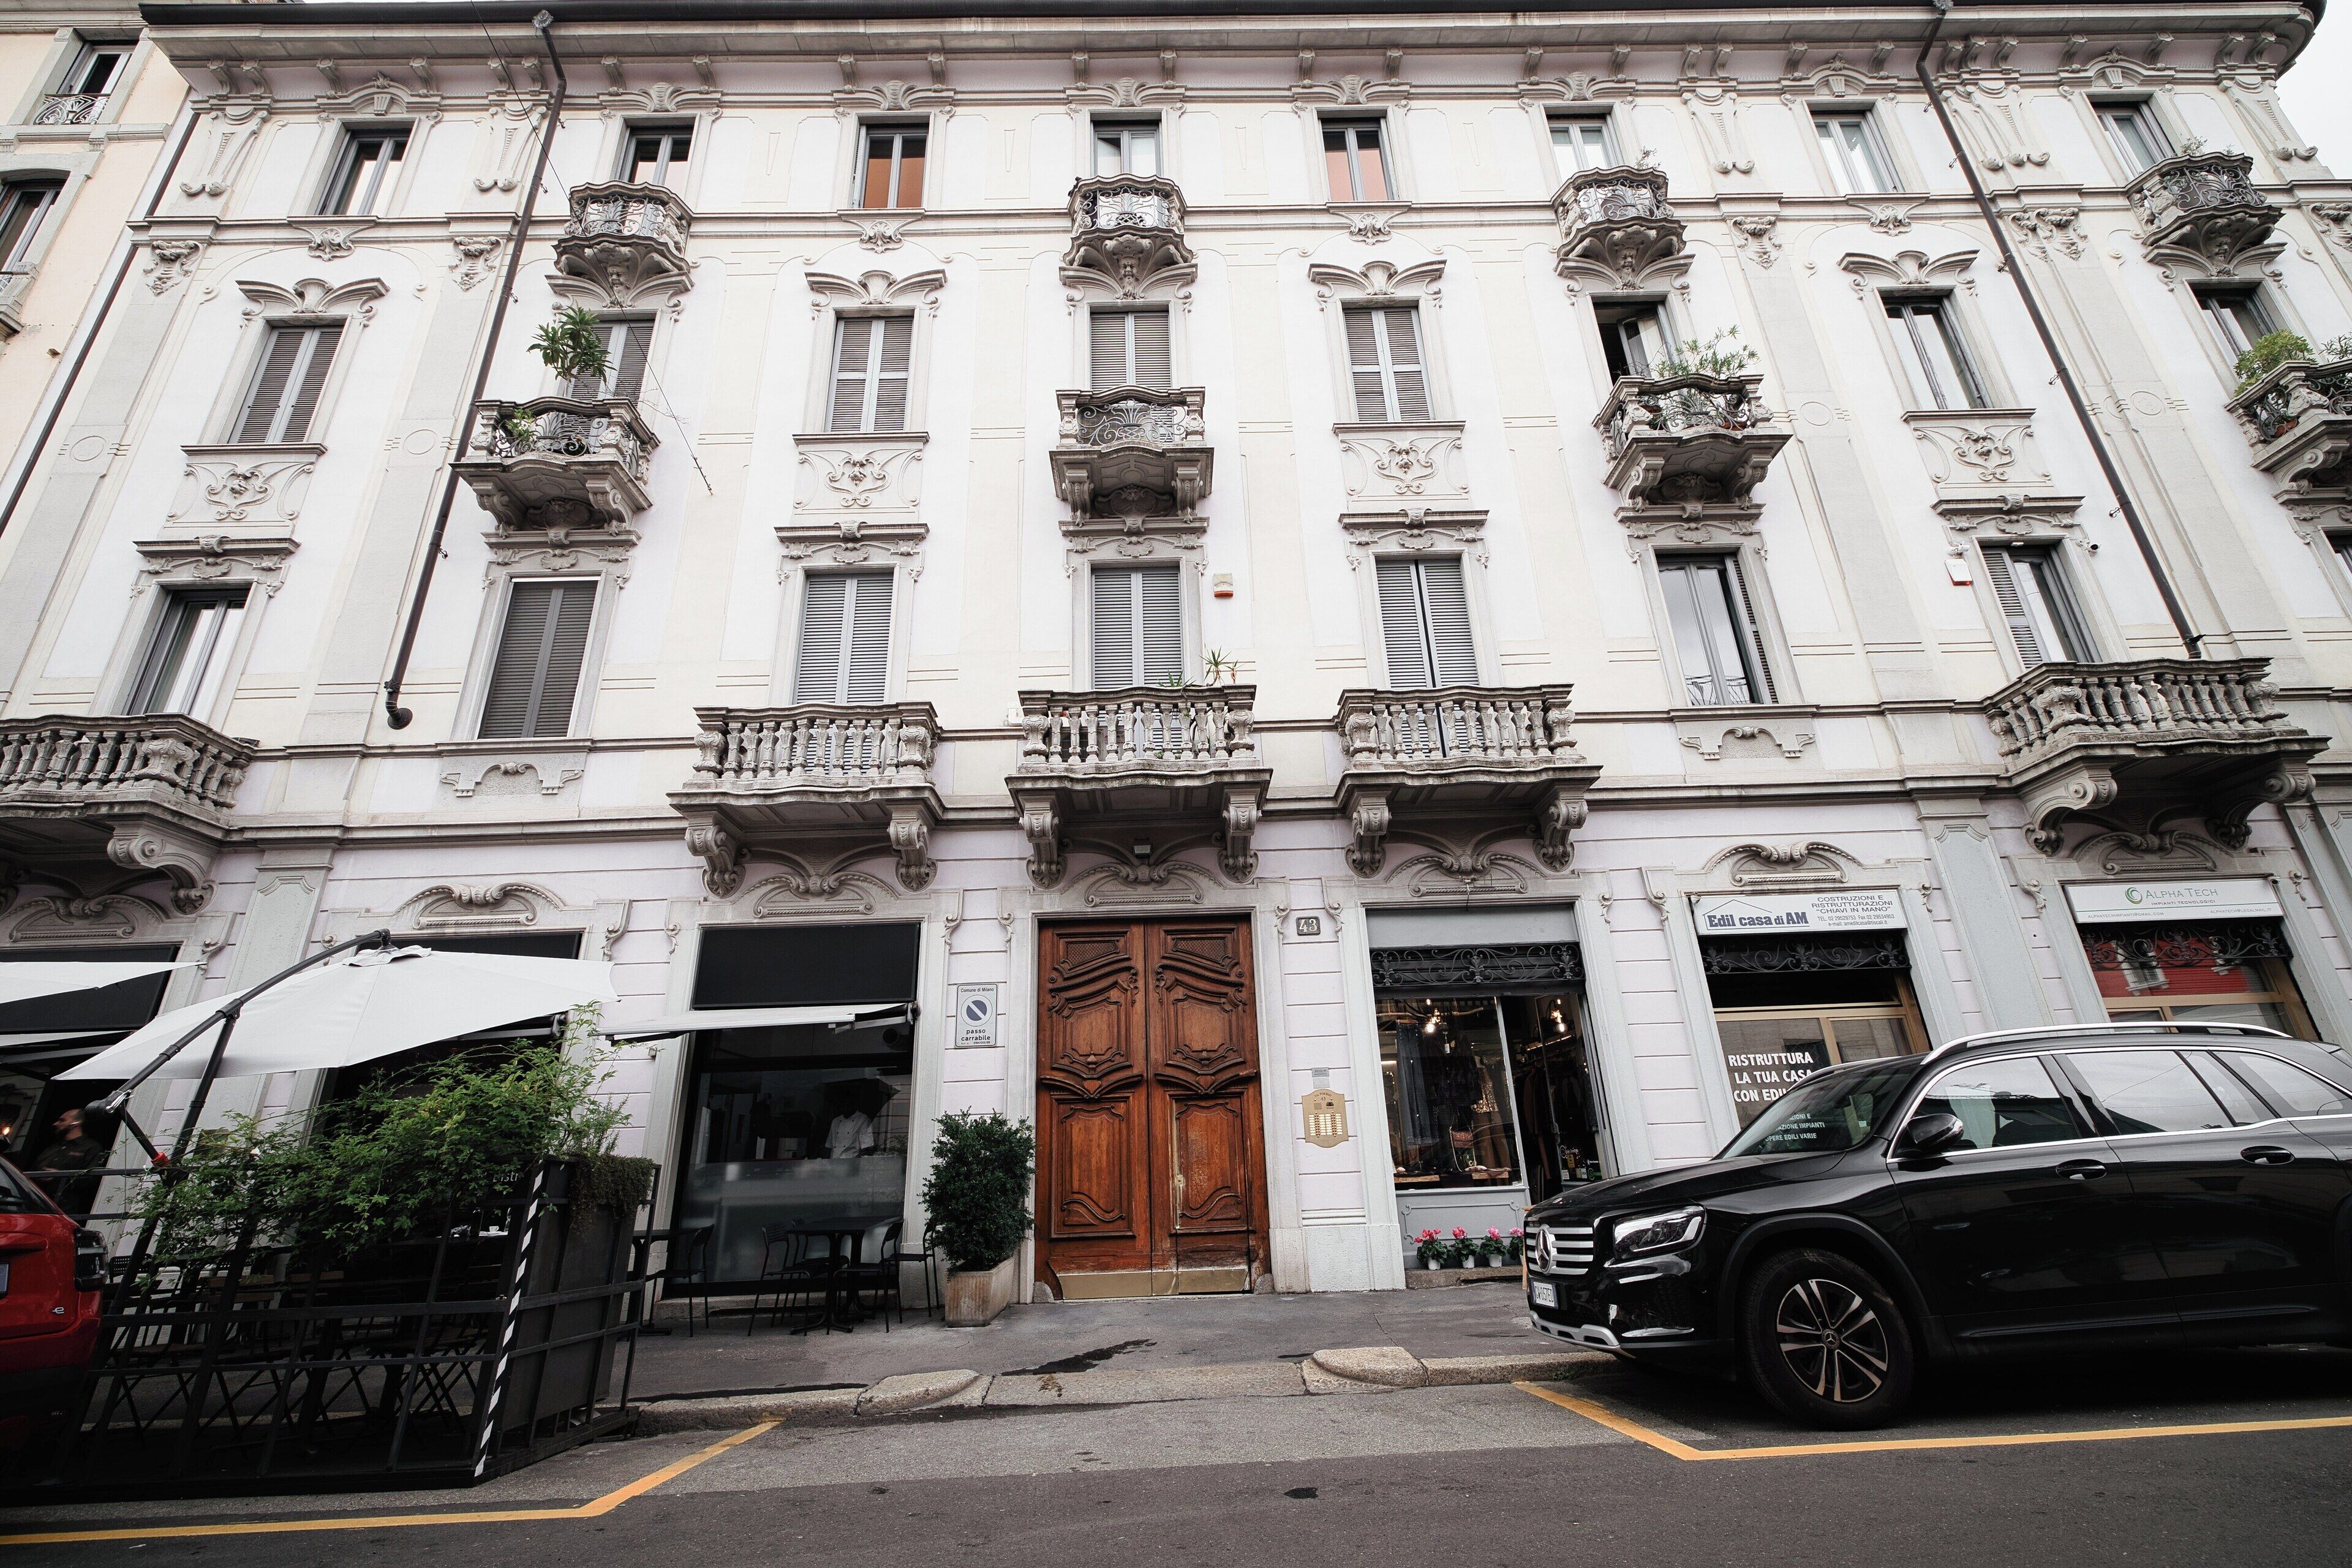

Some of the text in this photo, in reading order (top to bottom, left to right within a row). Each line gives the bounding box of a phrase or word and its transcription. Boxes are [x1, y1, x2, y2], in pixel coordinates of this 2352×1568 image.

[1299, 919, 1317, 932] 43
[1707, 911, 1809, 927] Edil casa di AM
[1727, 1052, 1814, 1067] RISTRUTTURA
[1734, 1072, 1752, 1084] LA
[1754, 1071, 1780, 1084] TUA
[1733, 1089, 1759, 1102] CON
